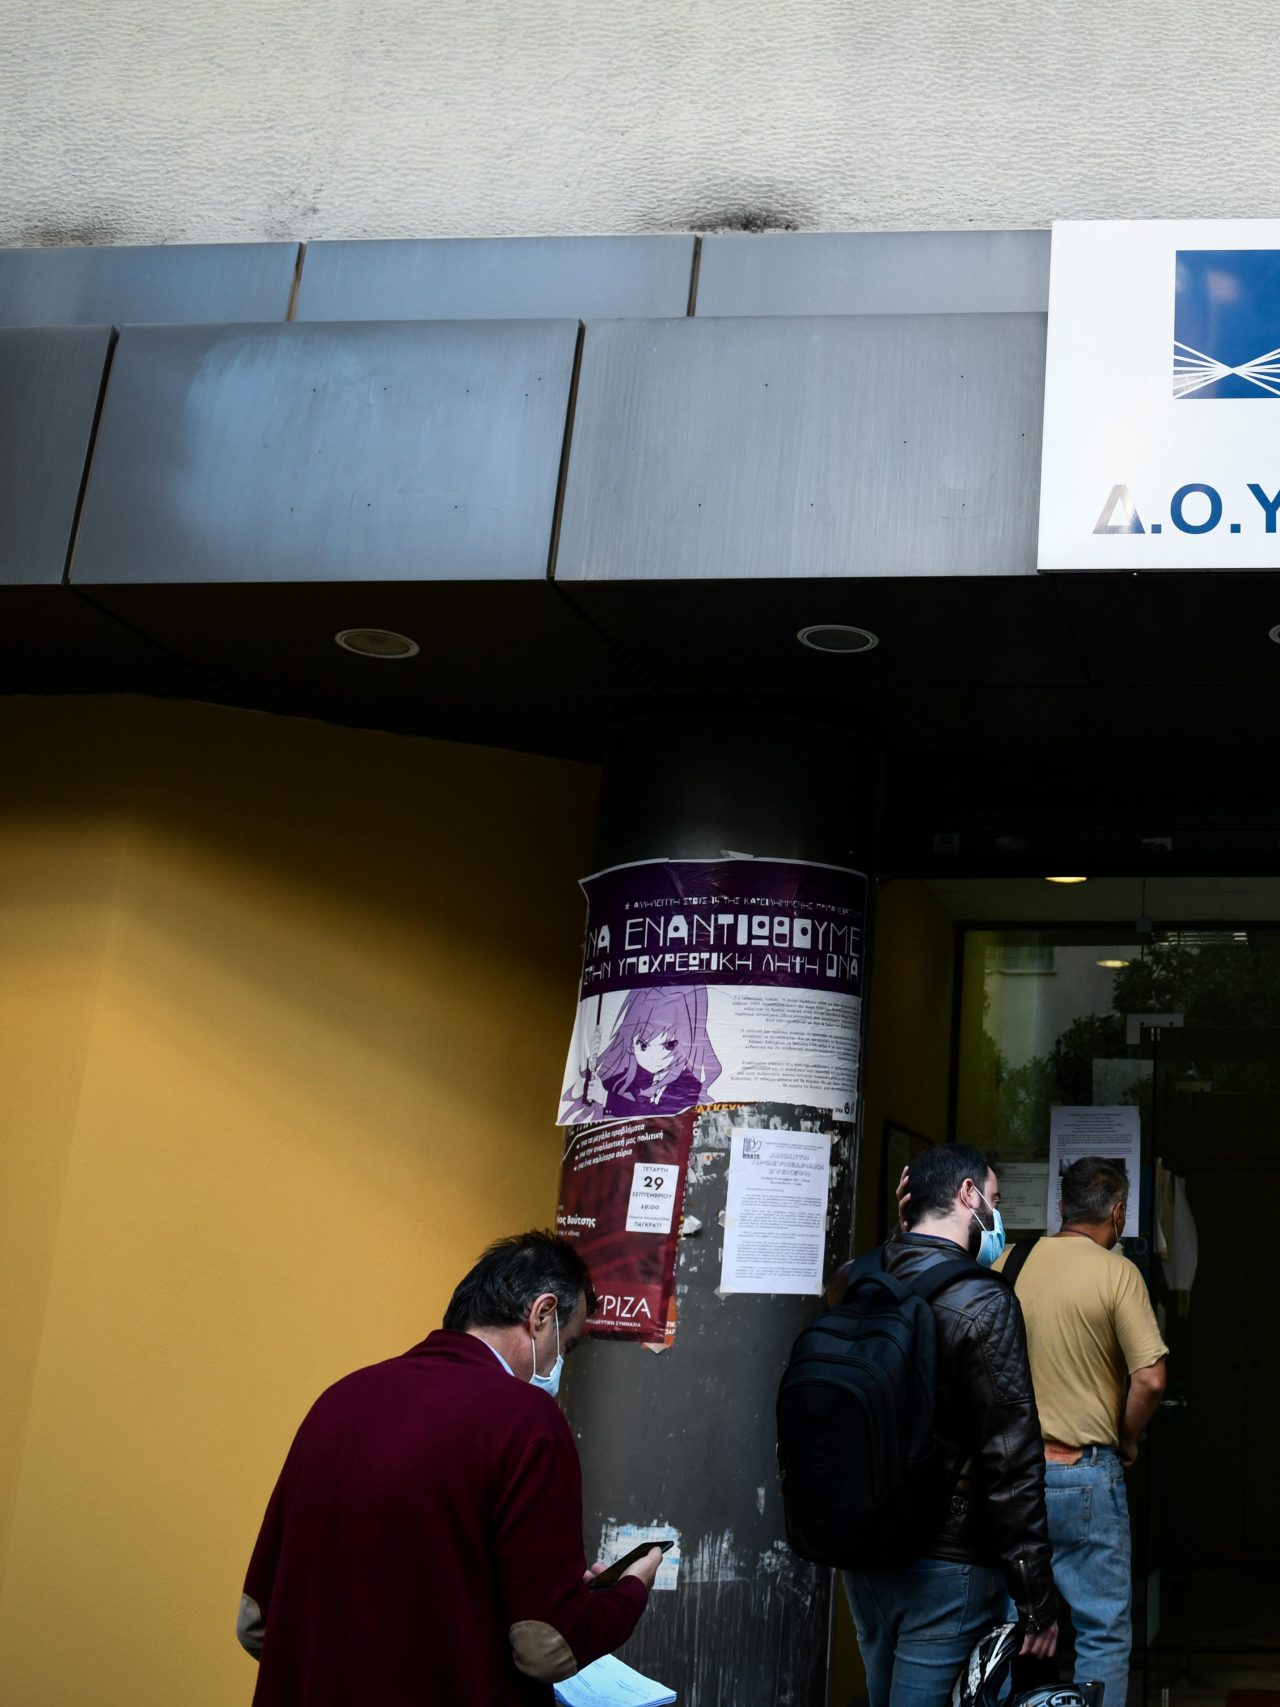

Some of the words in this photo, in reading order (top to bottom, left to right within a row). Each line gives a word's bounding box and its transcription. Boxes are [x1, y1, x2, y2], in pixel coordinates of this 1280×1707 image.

[586, 924, 611, 960] ΝΑ
[624, 913, 861, 958] ΕΝΑΝΤΙΩΘΟΥΜΕ
[583, 960, 612, 985] ΣΤΗΝ
[618, 952, 753, 977] ΥΠΟΧΡΕΩΤΙΚΗ
[762, 953, 819, 975] ΛΗΨΗ
[611, 1124, 646, 1139] προβλήματα
[637, 1129, 664, 1142] πολιτική
[643, 1175, 664, 1191] 29
[632, 1191, 672, 1199] ΣΕΠΤΕΜΒΡΙΟΥ
[567, 1213, 596, 1228] Βούτσης
[597, 1294, 651, 1319] ΡΙΖΑ
